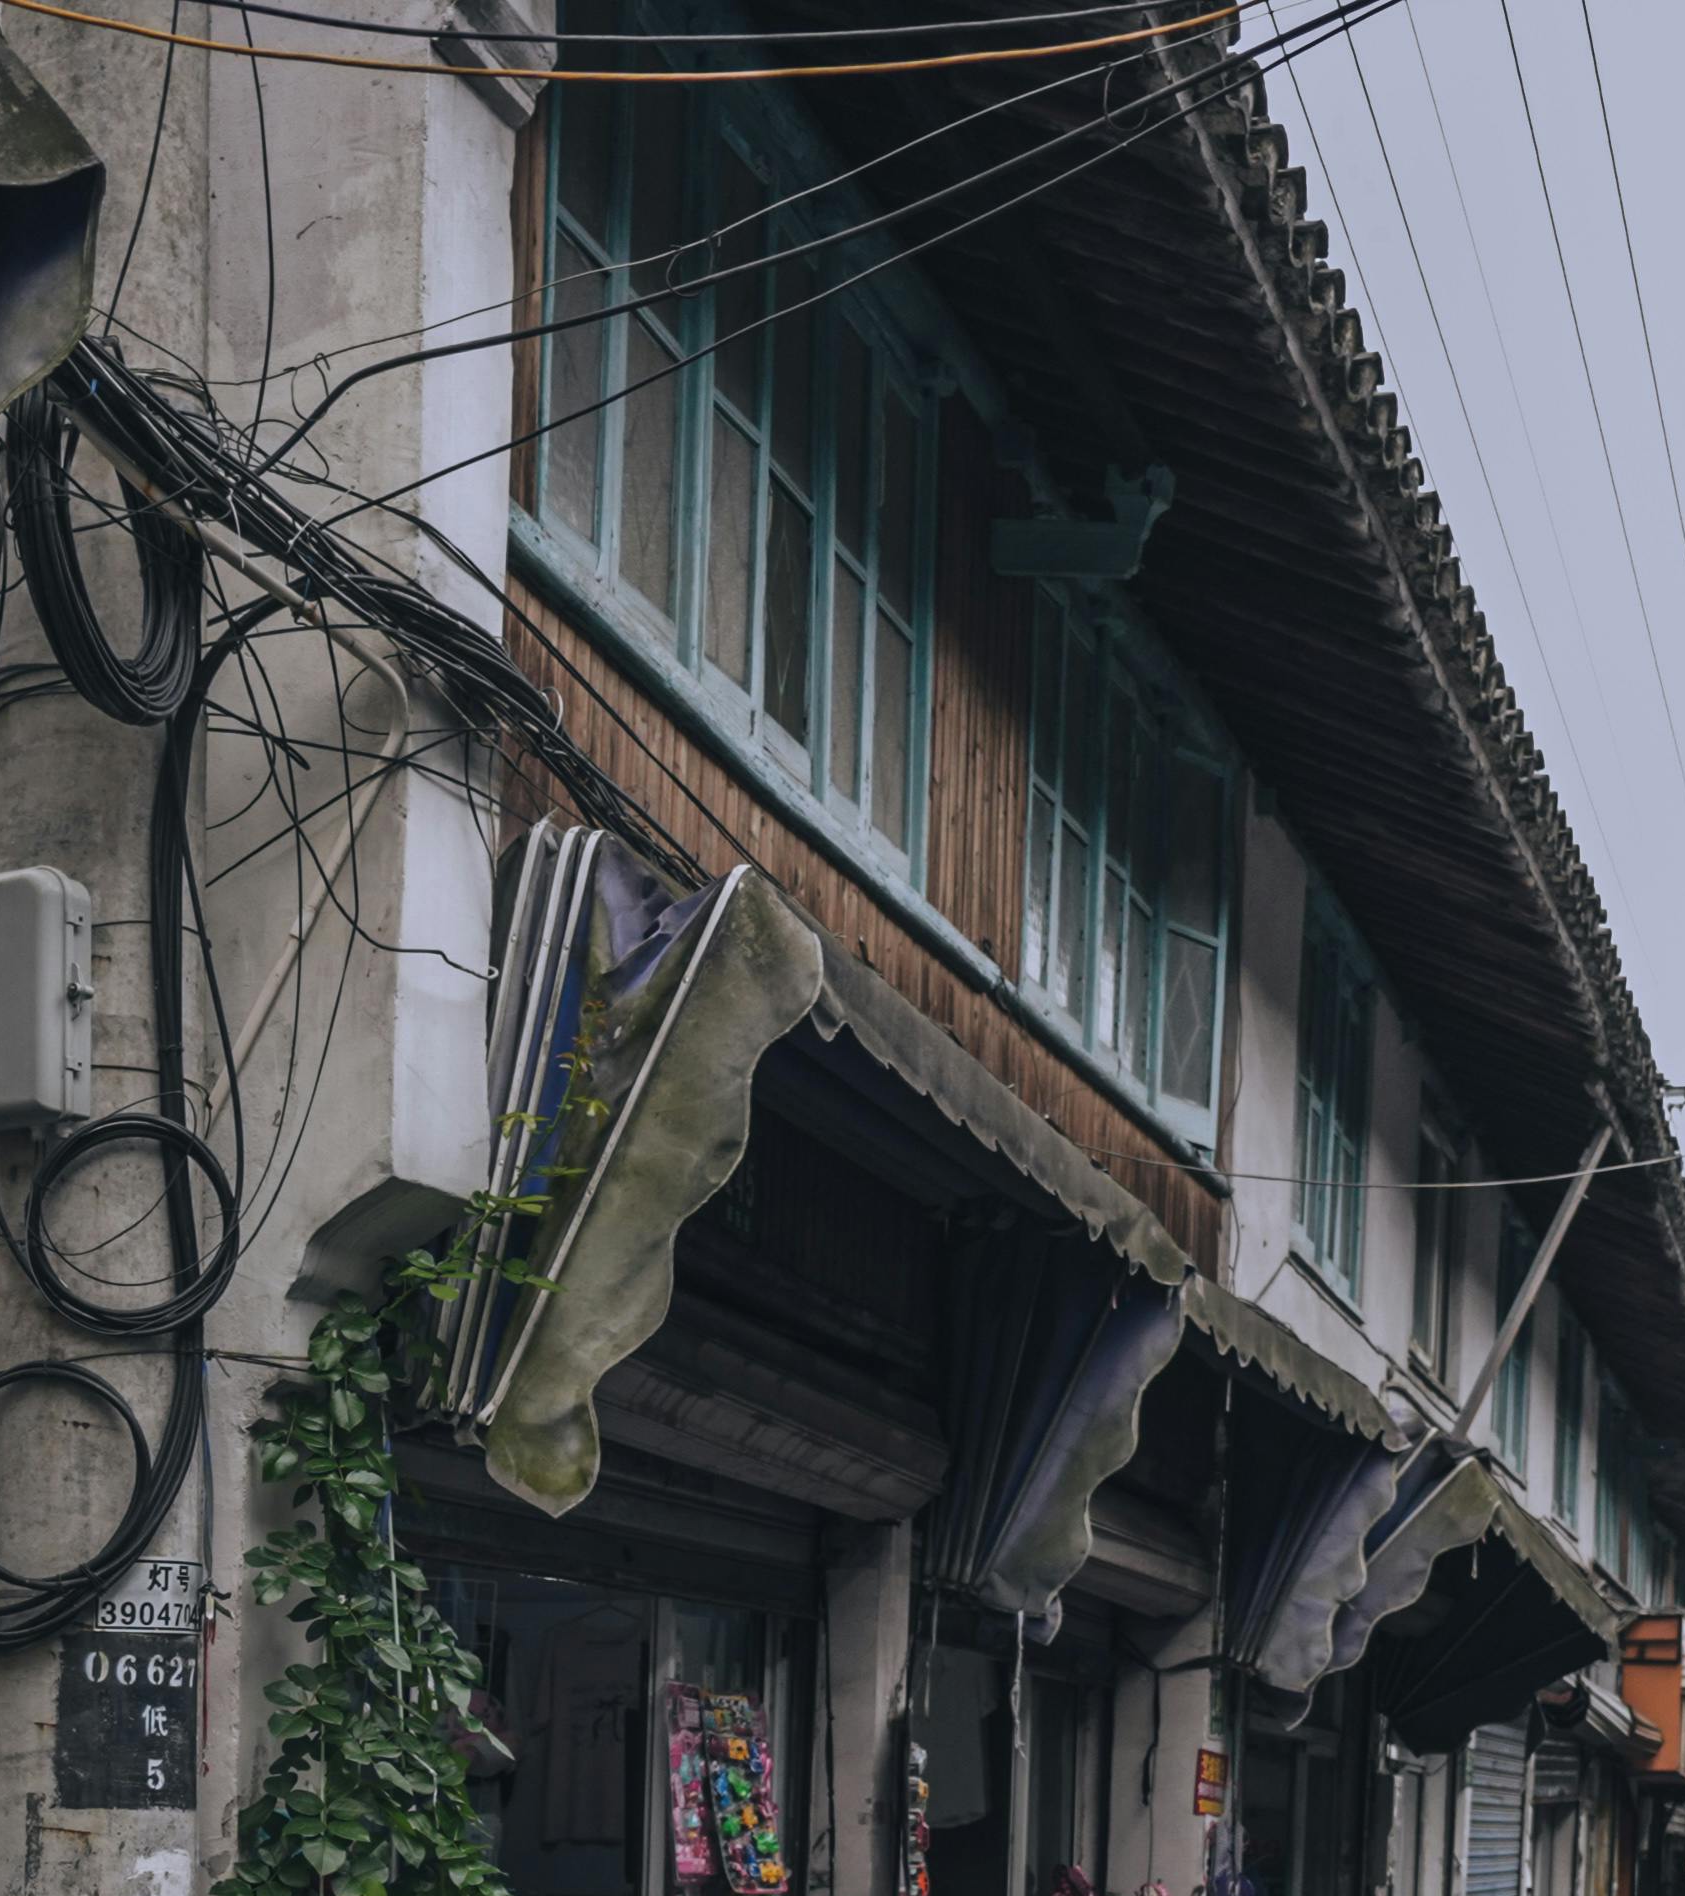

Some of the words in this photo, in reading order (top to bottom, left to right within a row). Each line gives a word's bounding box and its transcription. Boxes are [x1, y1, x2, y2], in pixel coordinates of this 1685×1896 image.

[148, 1564, 190, 1593] 灯号
[142, 1704, 168, 1737] 低
[146, 1758, 165, 1791] 5
